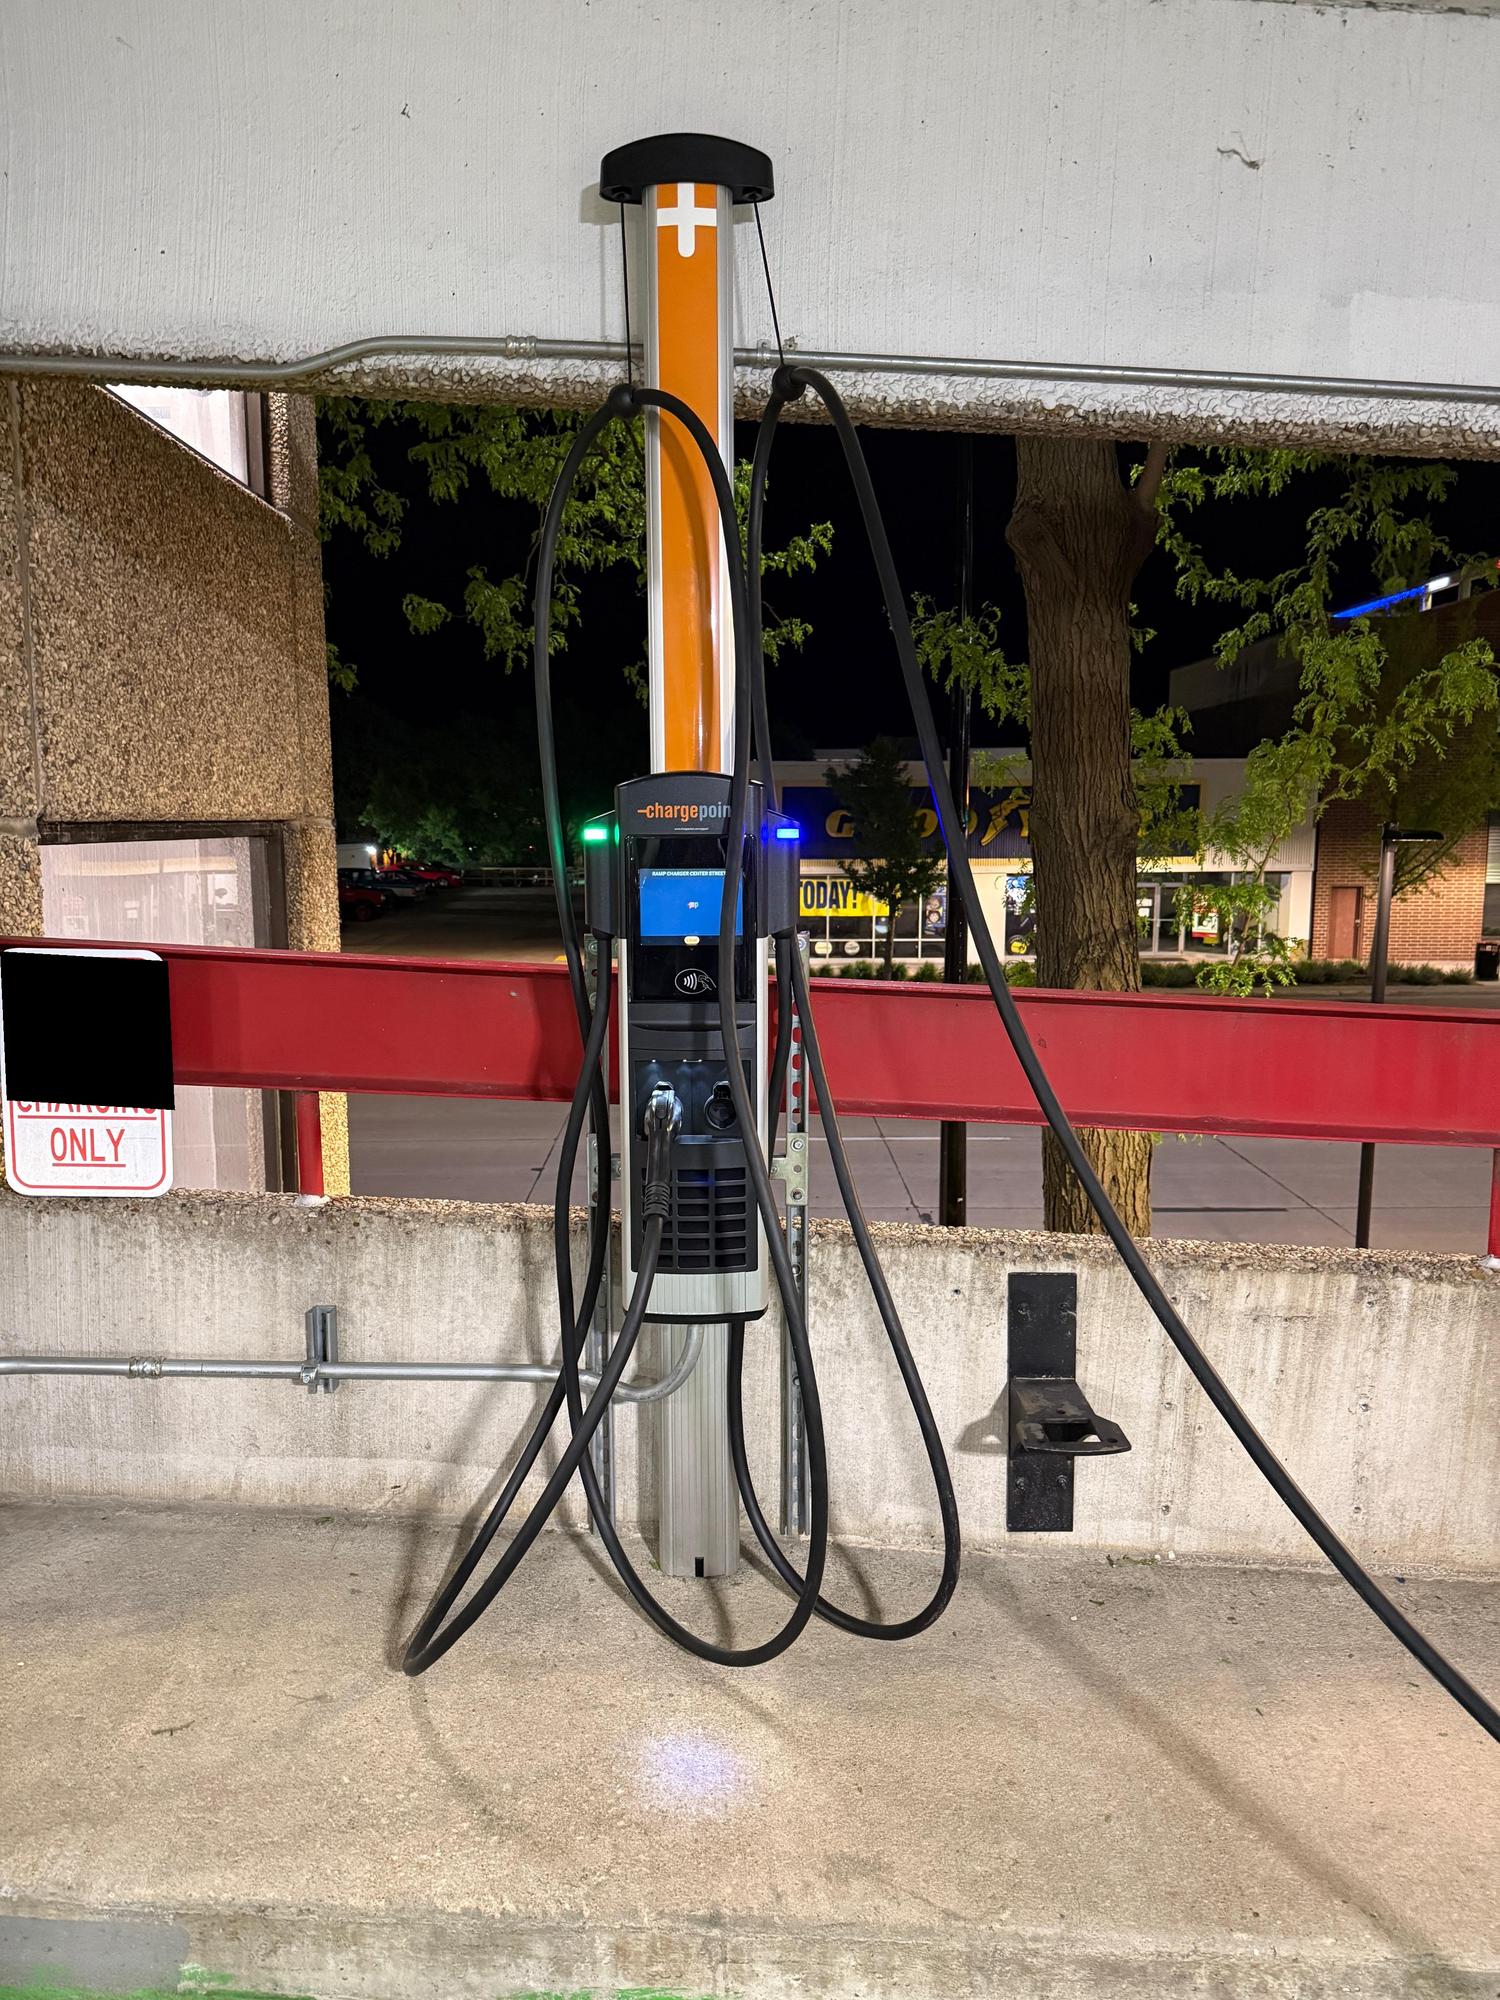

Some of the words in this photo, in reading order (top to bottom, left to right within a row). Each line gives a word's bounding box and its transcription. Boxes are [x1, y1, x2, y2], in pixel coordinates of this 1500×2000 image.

[646, 801, 731, 822] chargepoin
[800, 880, 857, 909] ODAY!
[50, 1127, 126, 1162] ONLY
